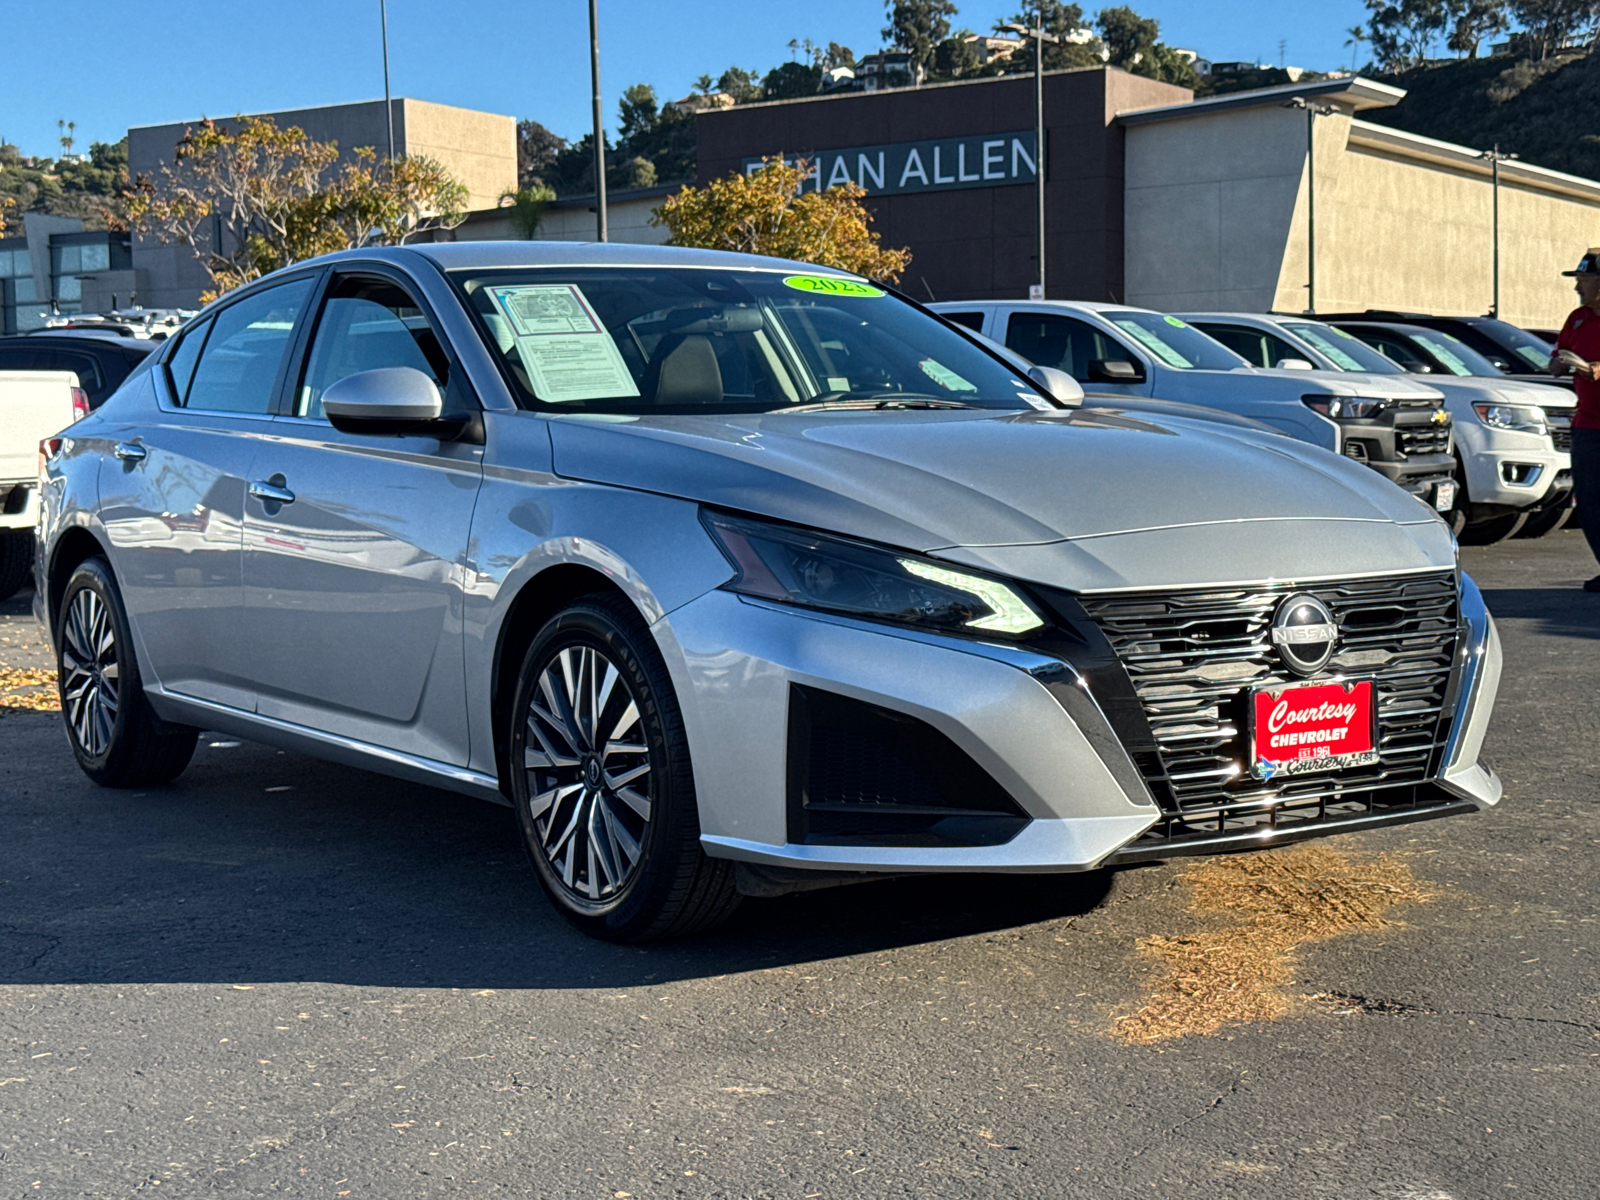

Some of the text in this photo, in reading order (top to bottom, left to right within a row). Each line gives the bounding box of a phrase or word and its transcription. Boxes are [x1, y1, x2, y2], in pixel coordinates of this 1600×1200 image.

[747, 138, 1037, 195] HAN ALLEN
[803, 279, 868, 293] 2023
[1275, 627, 1337, 642] NISSAN
[1268, 700, 1357, 733] Courtesy
[1270, 727, 1349, 748] CHEVROLET
[1286, 756, 1348, 776] Courtesy
